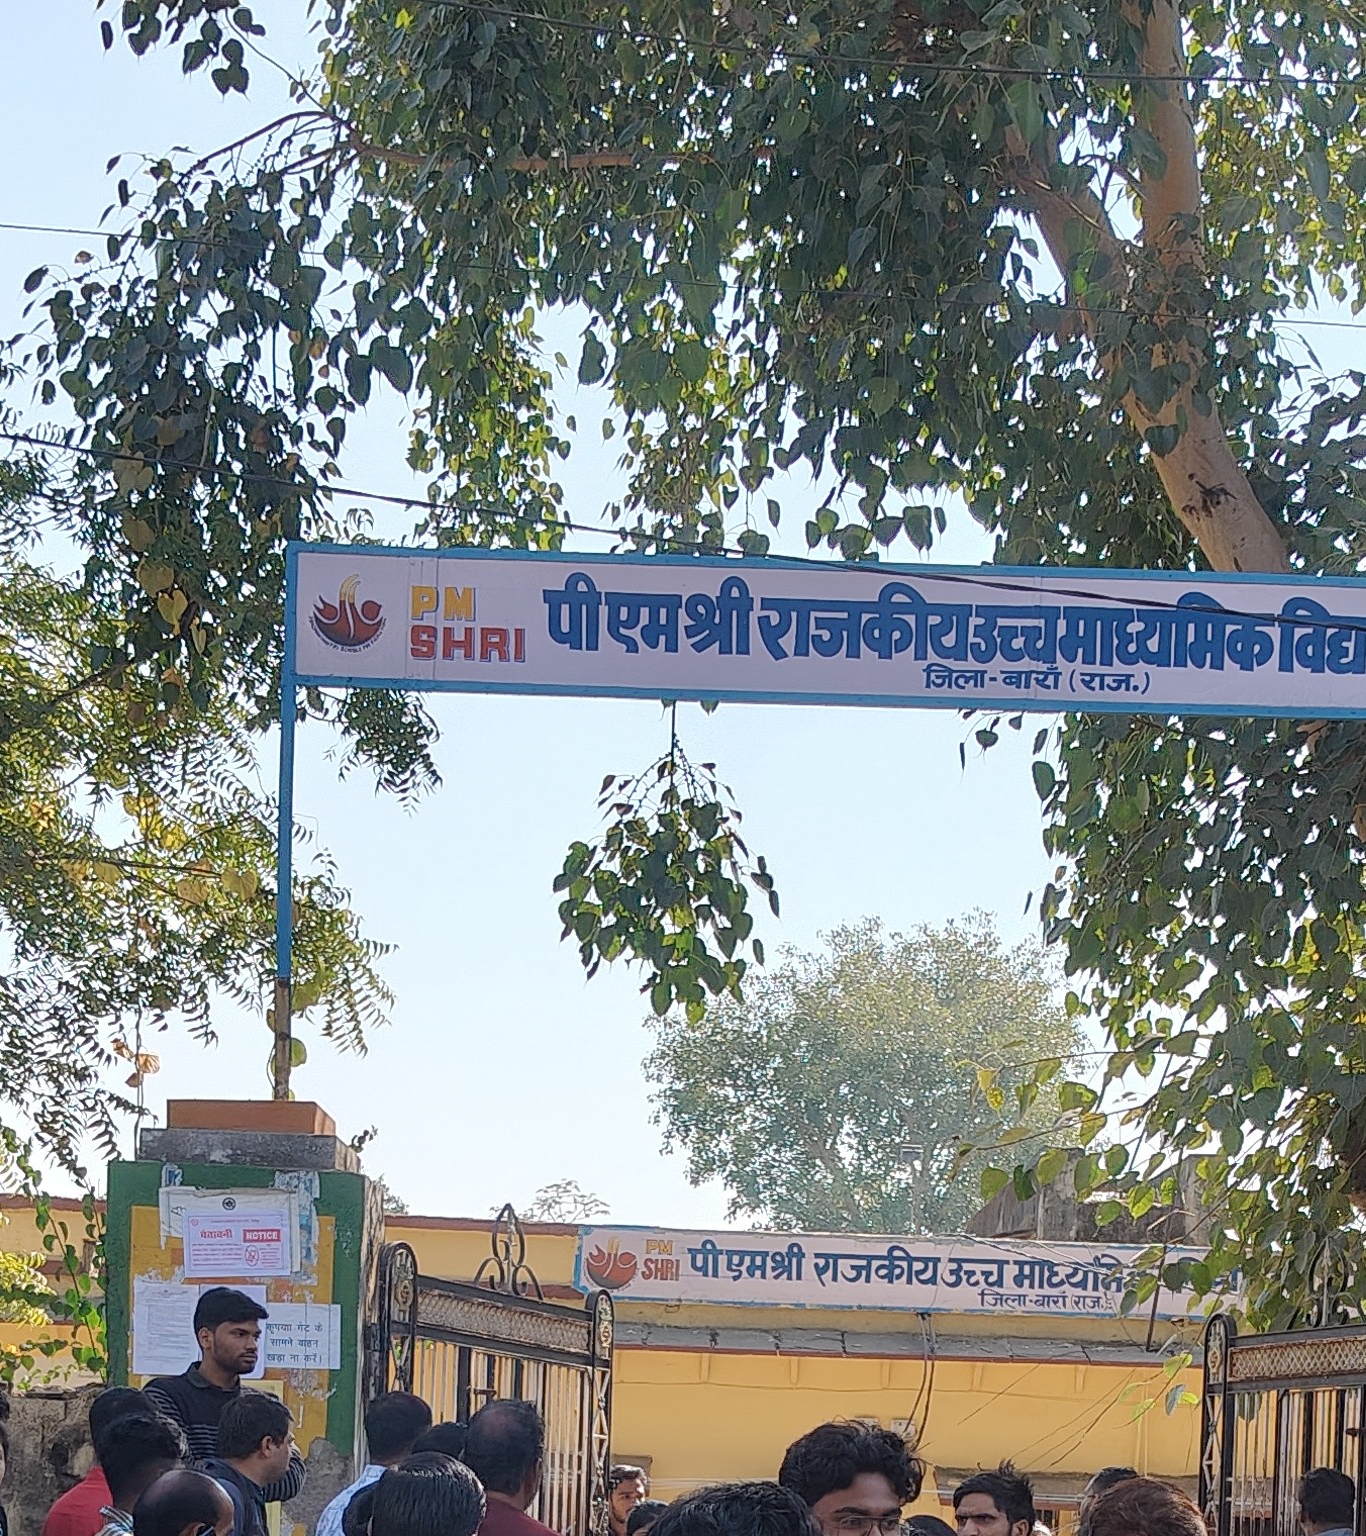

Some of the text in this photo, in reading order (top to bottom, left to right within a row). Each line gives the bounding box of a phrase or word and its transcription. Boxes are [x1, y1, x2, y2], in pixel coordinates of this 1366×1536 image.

[411, 585, 476, 621] PM
[410, 625, 525, 663] SHRI
[646, 1239, 672, 1256] PM
[641, 1257, 680, 1281] SHRI
[813, 1245, 941, 1288] राजकीय
[941, 1257, 1010, 1289] उच्च
